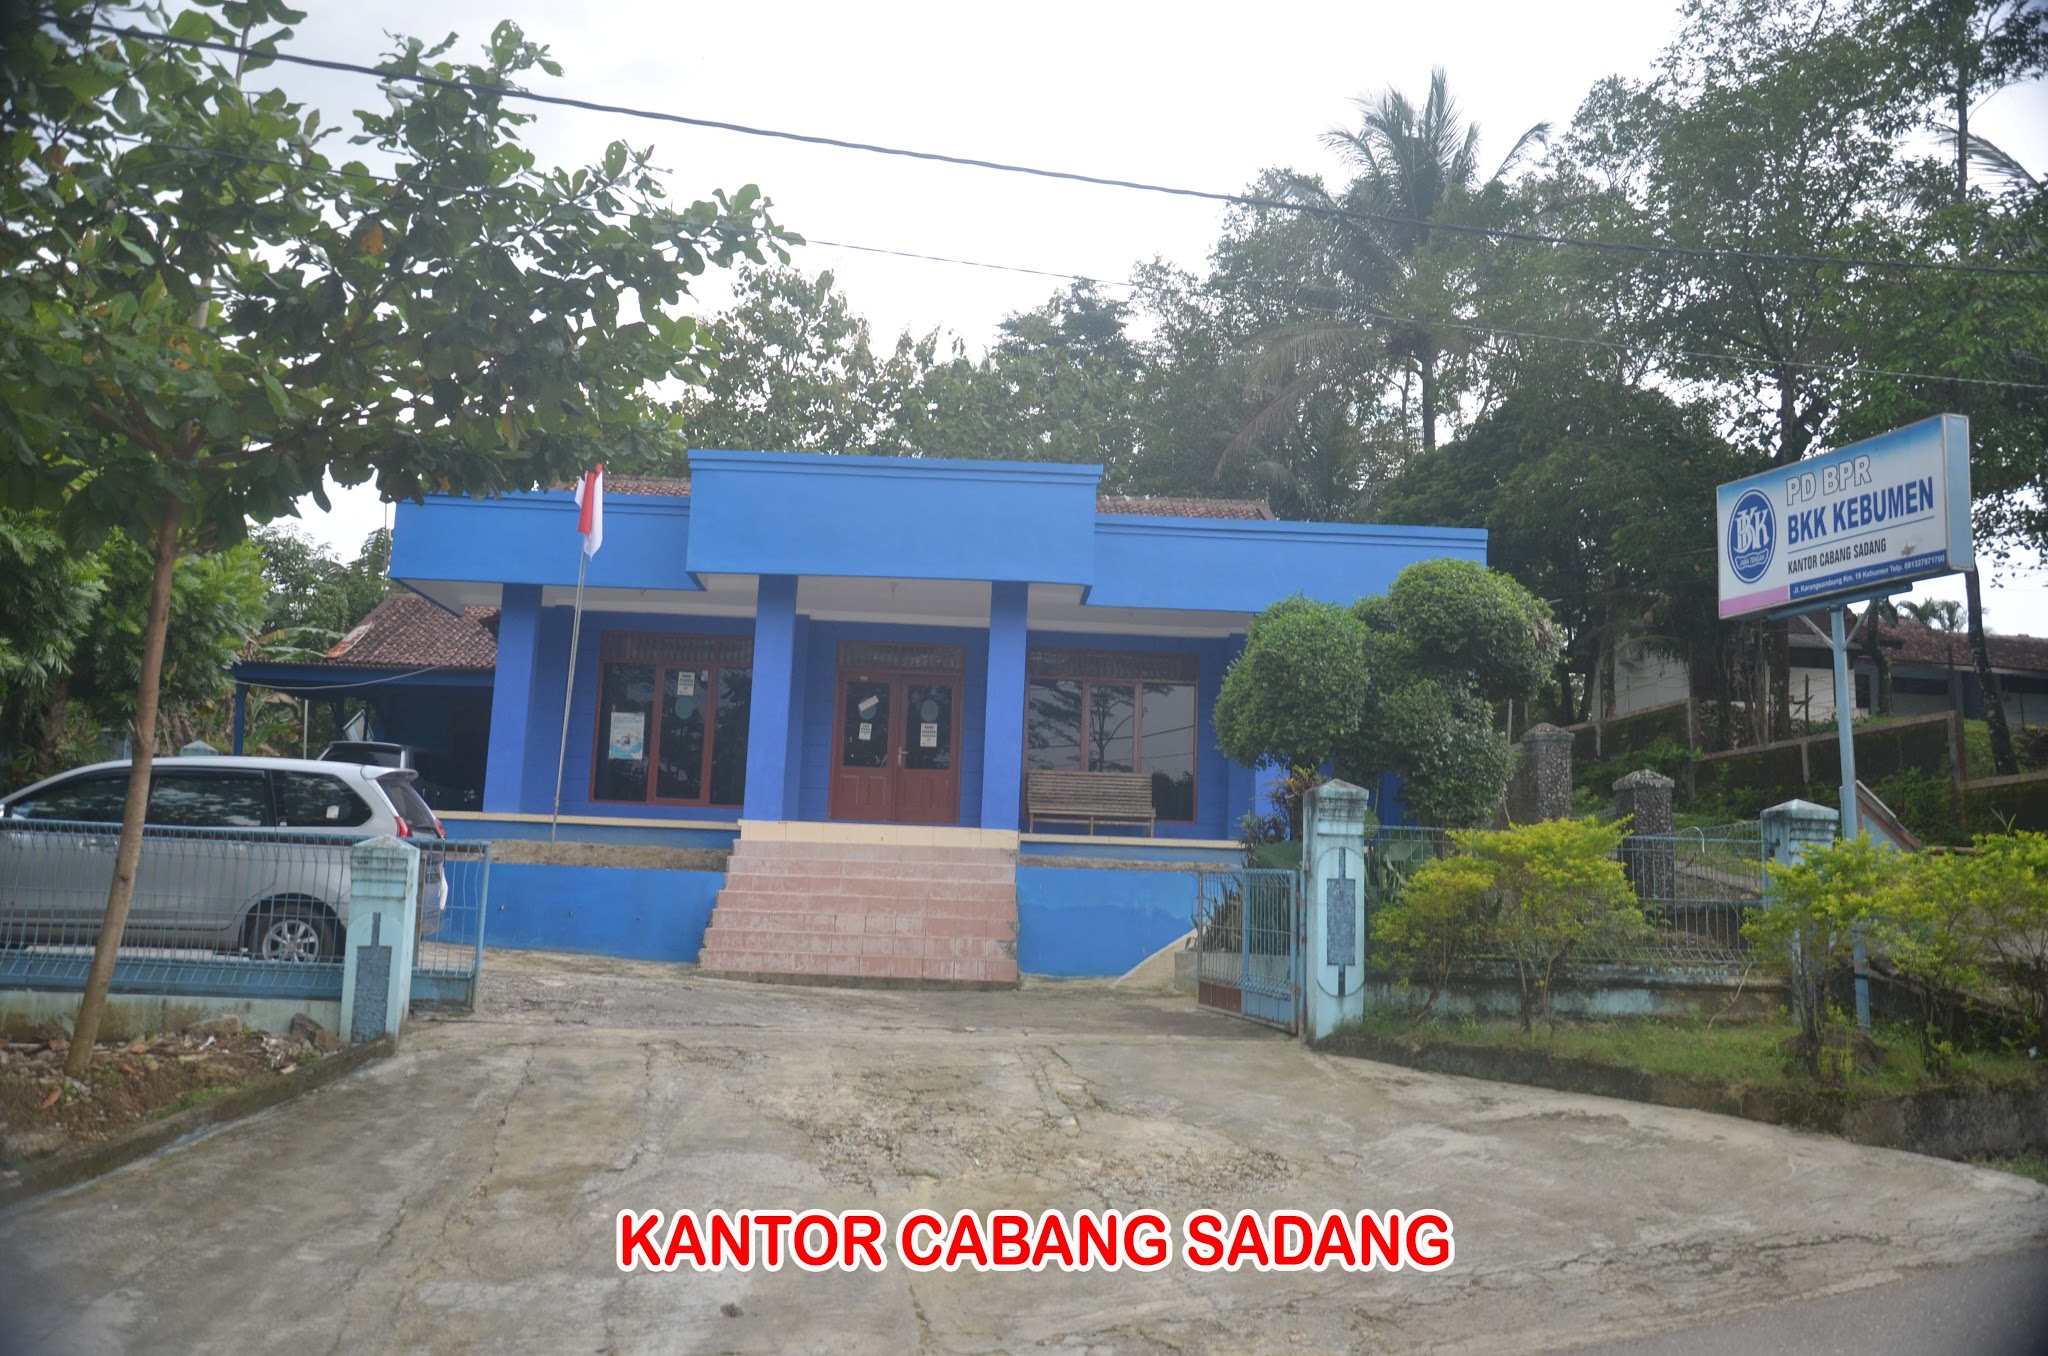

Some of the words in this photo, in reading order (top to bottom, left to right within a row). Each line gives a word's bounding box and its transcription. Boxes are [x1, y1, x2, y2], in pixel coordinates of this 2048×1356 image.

[1786, 472, 1816, 506] PD
[1822, 455, 1872, 496] BPR
[1788, 506, 1827, 545] BKK
[1833, 476, 1934, 533] KEBUMEN
[1788, 555, 1817, 574] KANTOR
[1820, 546, 1851, 567] CABANG
[1853, 538, 1887, 558] SADANG
[1862, 567, 1889, 578] Kebumen
